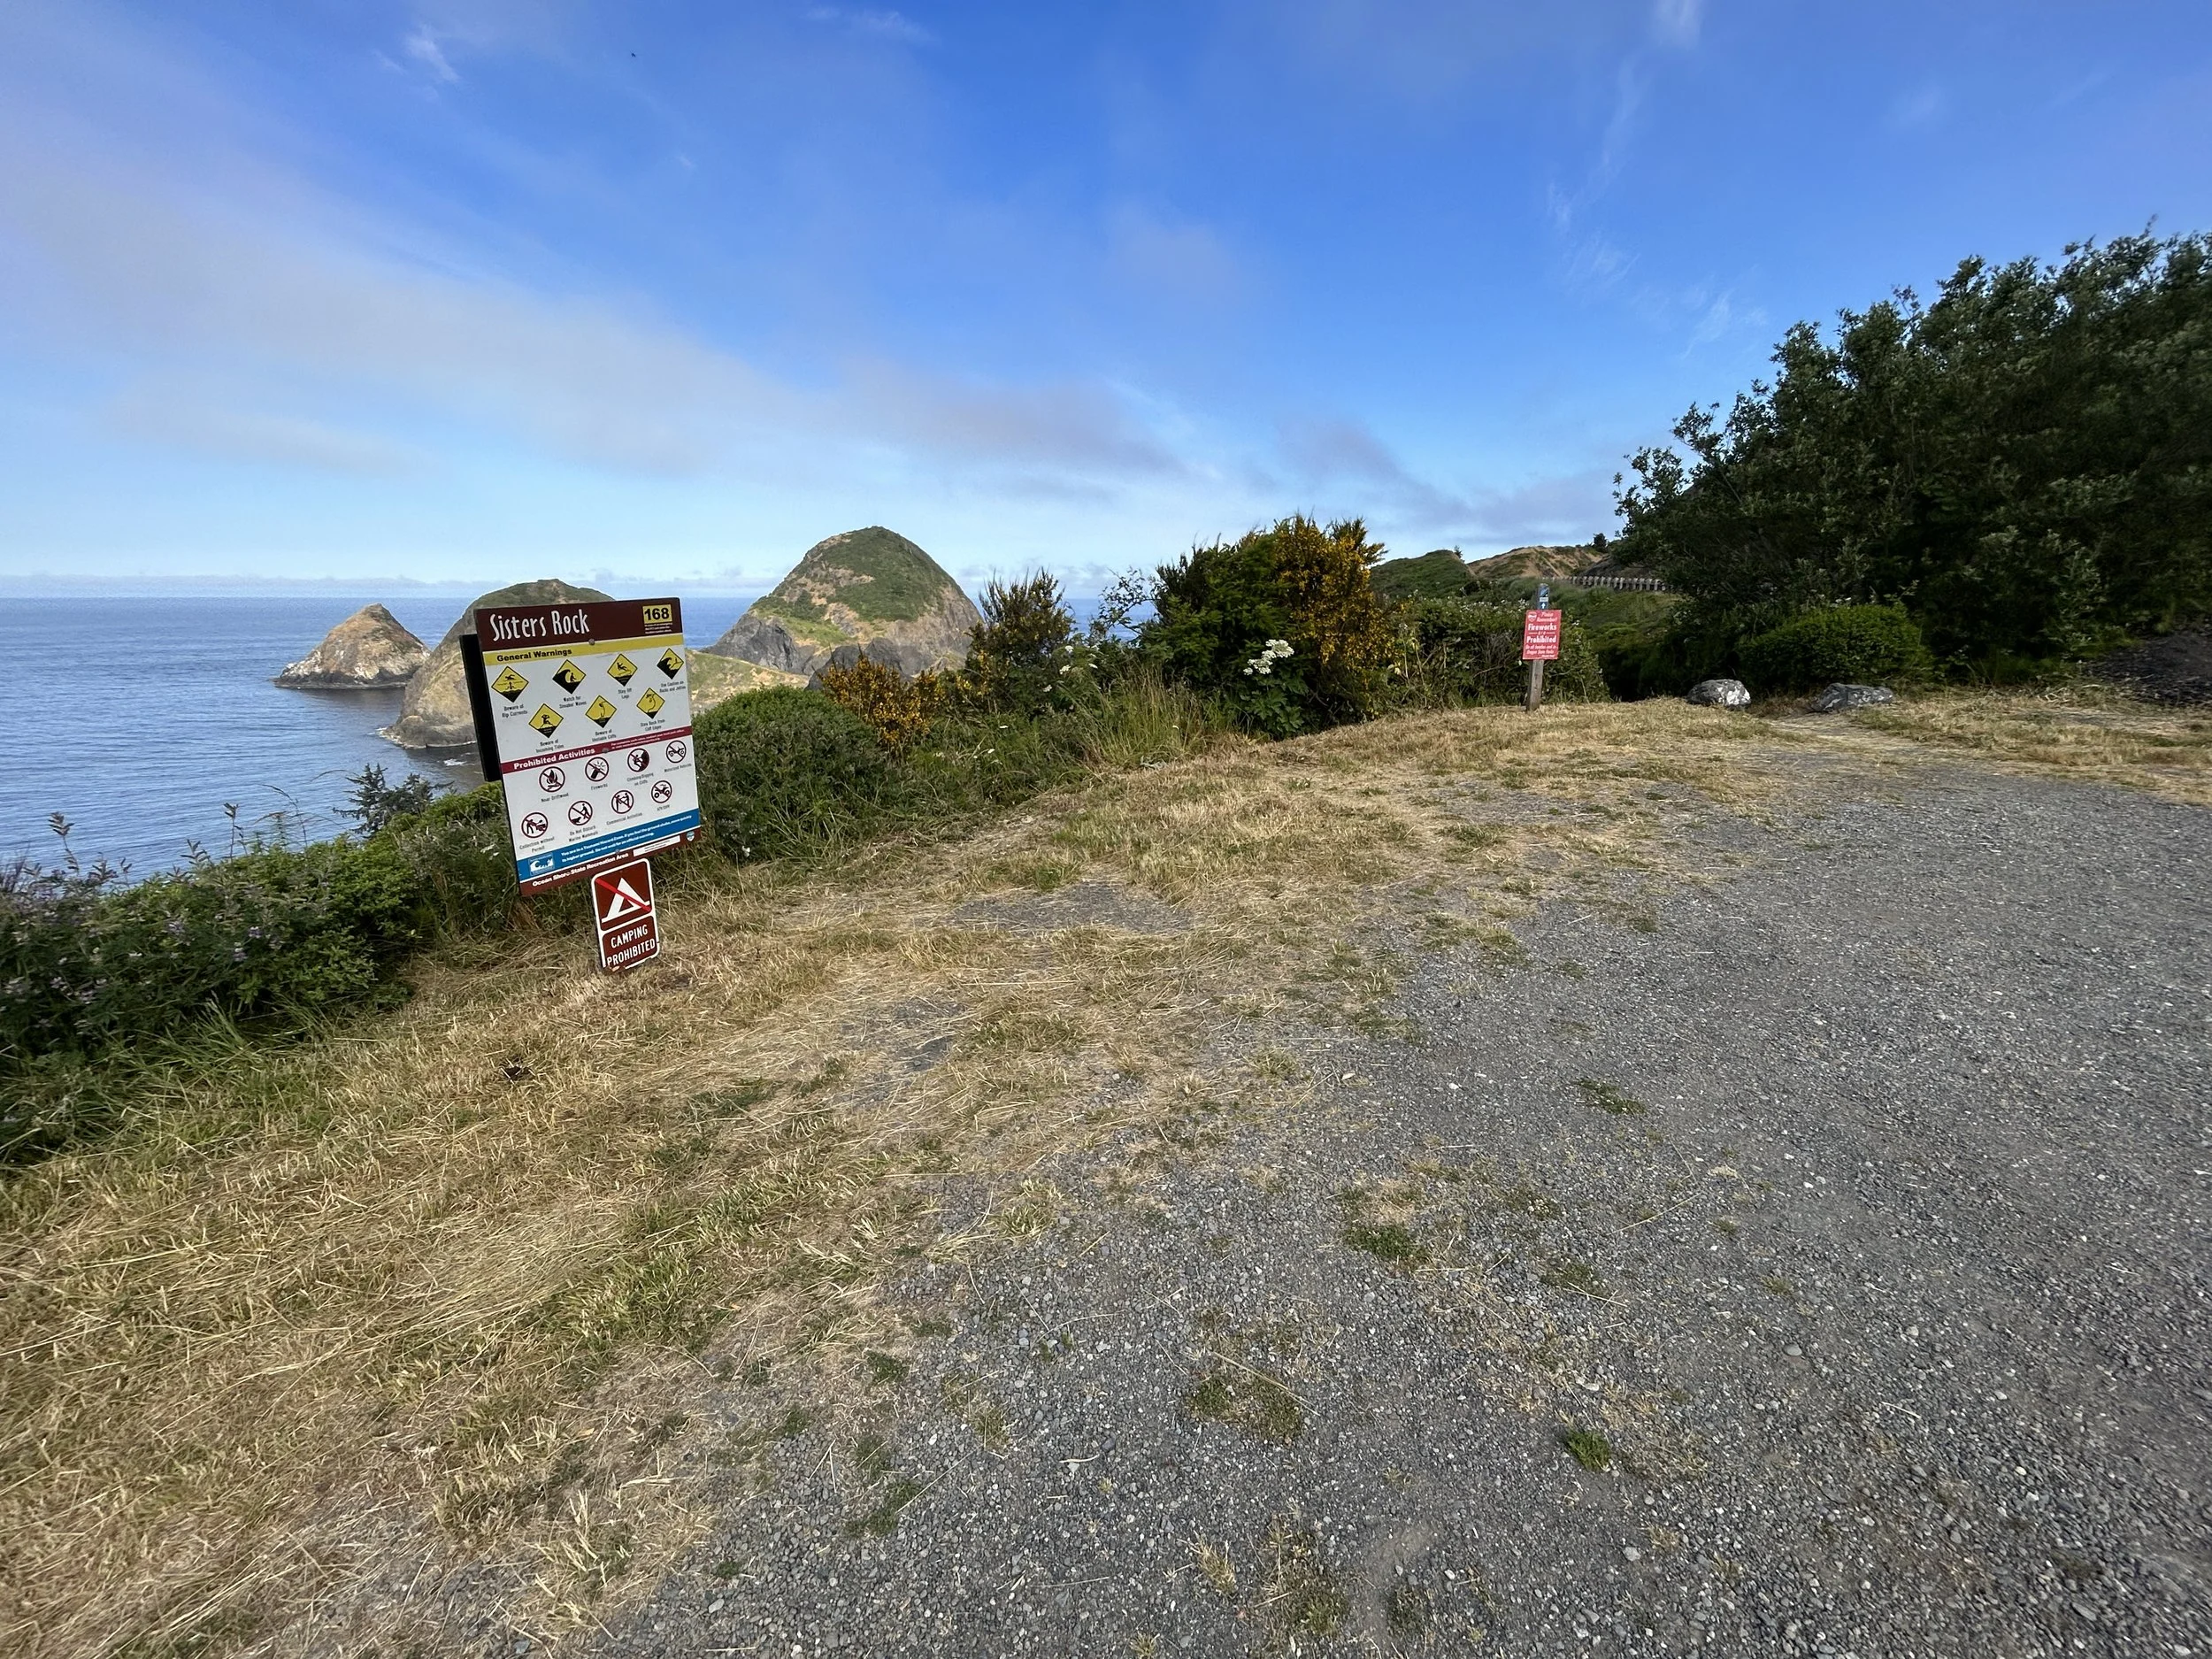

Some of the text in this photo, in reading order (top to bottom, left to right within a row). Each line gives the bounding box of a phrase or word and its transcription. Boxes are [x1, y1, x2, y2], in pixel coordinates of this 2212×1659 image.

[489, 609, 590, 641] Sisters Rock
[644, 607, 670, 620] 168
[1526, 634, 1557, 643] Prohibited
[497, 649, 572, 662] General Warnings
[513, 748, 595, 770] Prohibited Activities
[532, 877, 553, 887] Ocean
[570, 866, 587, 875] State
[586, 856, 616, 870] Recreation
[611, 924, 648, 949] CAMPING
[606, 938, 656, 966] PROHIBITED
